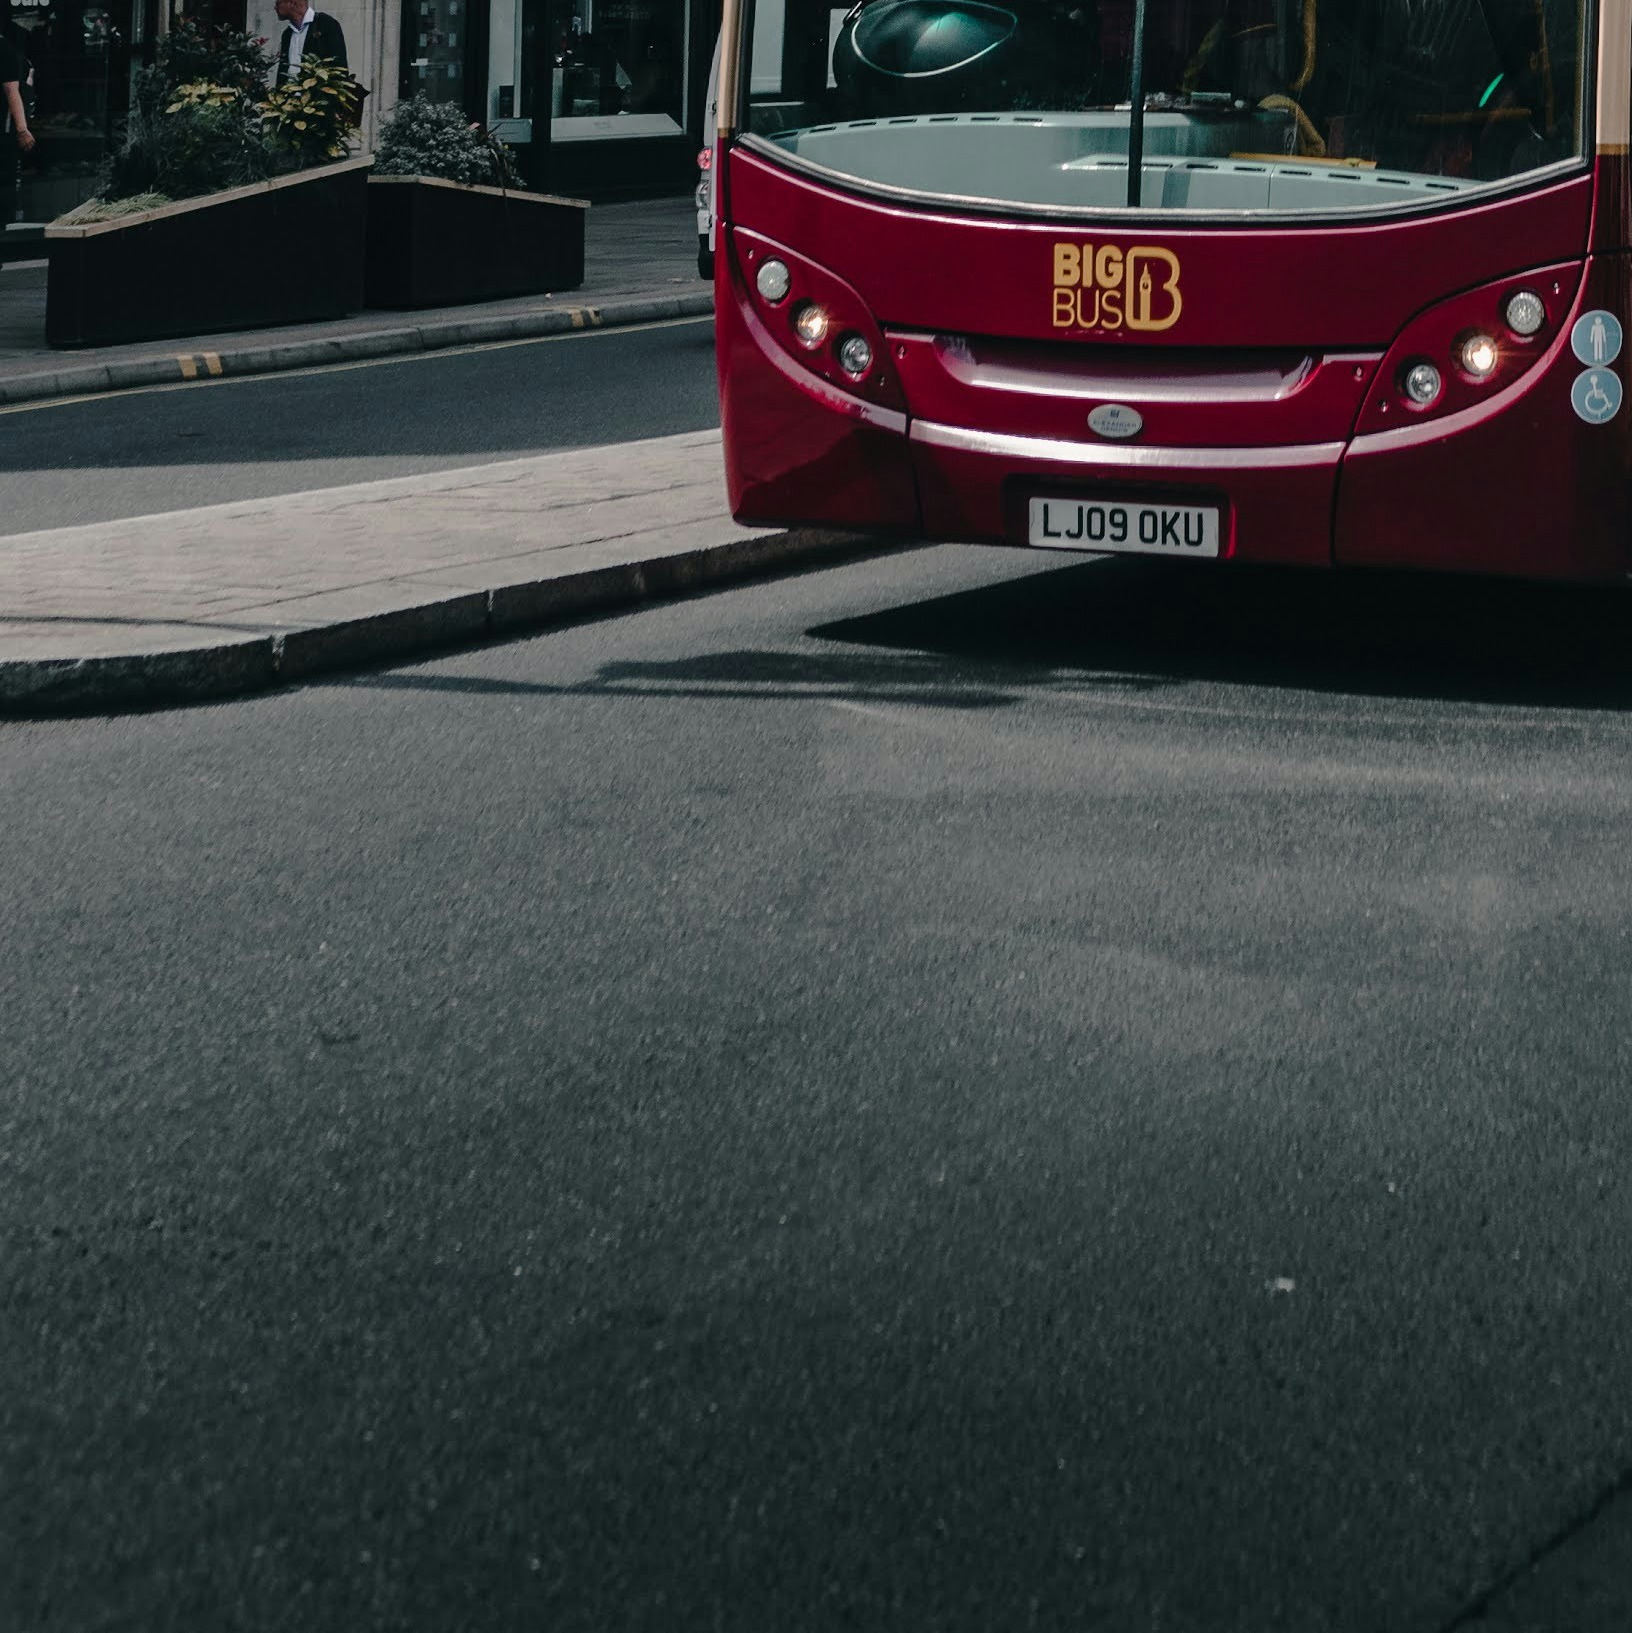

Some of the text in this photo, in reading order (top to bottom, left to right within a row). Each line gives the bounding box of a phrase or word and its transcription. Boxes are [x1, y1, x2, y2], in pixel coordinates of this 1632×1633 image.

[1053, 243, 1124, 288] BIG
[1053, 288, 1123, 329] BUS
[1043, 503, 1204, 547] LJ09 OKU
